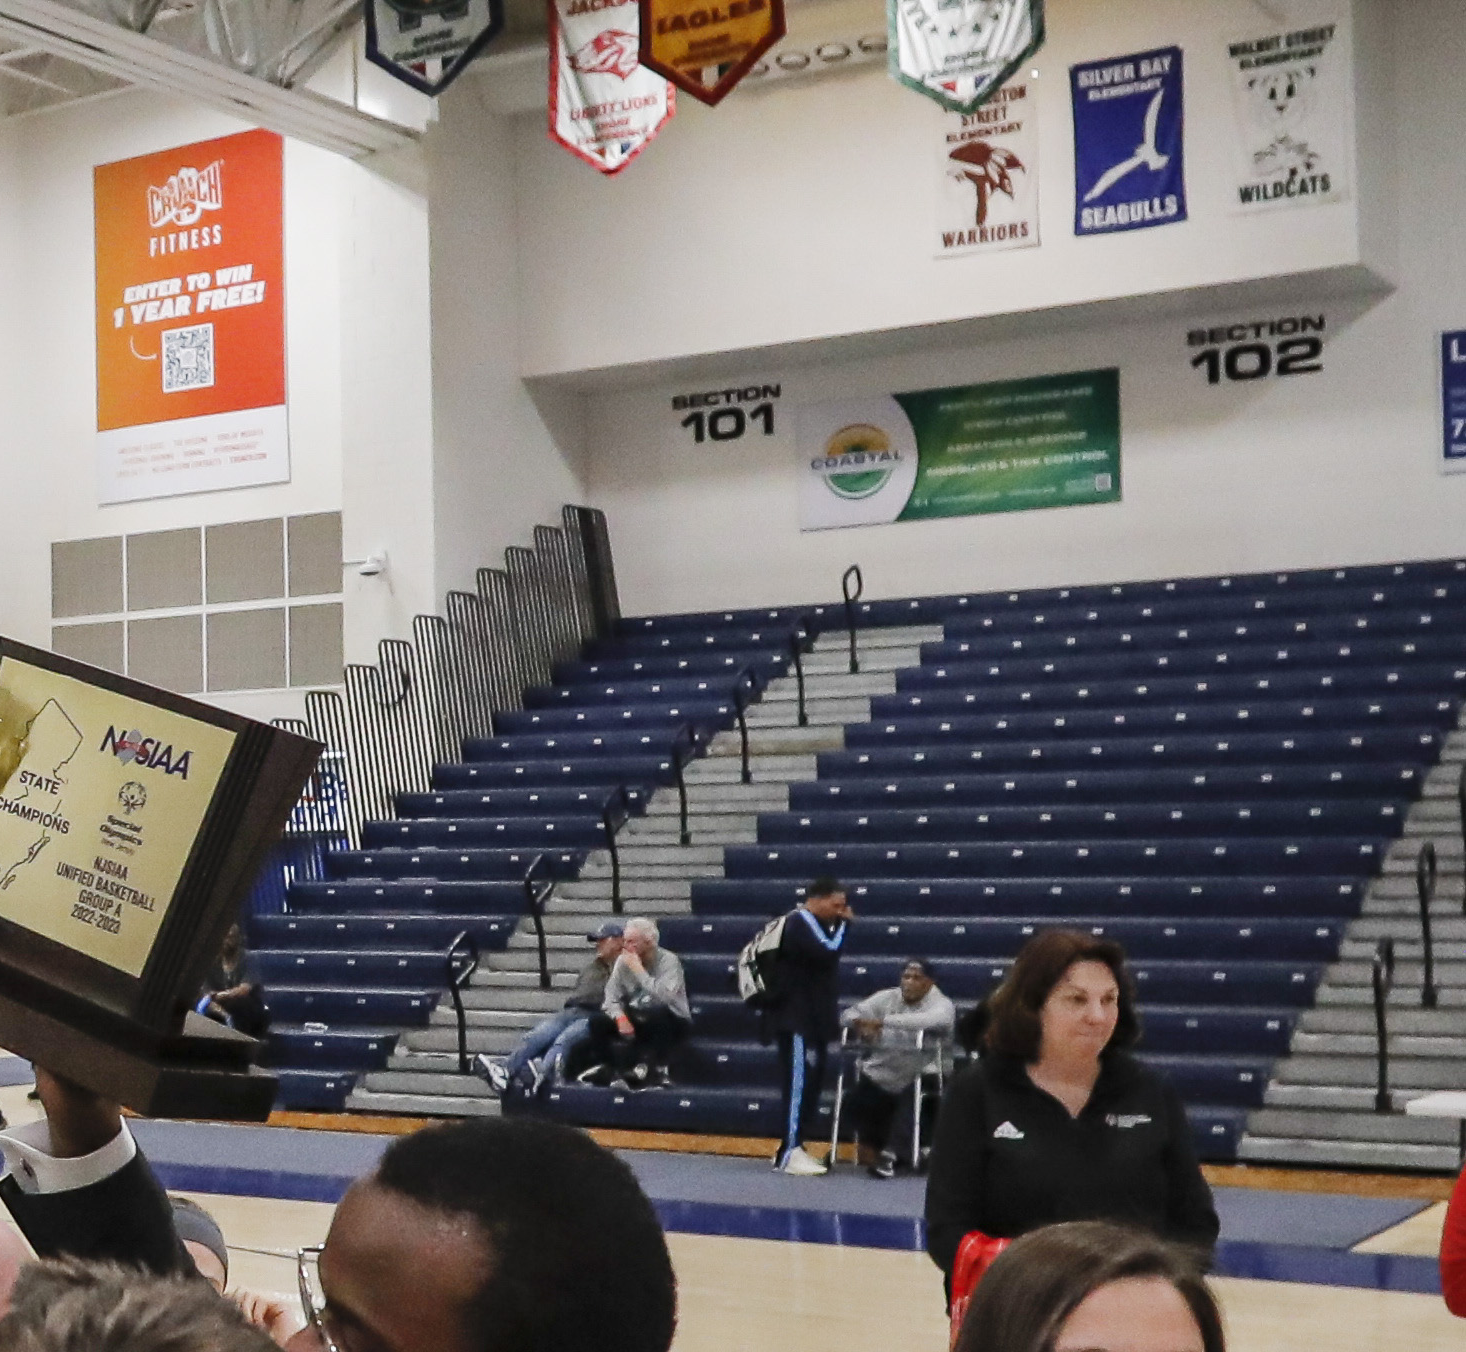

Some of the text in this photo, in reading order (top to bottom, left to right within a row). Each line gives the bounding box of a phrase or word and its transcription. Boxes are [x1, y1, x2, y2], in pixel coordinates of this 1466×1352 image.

[1078, 55, 1171, 88] SILVER BAY
[1239, 173, 1331, 204] WILDCATS
[1081, 194, 1178, 228] SEAGULLS
[149, 224, 223, 258] FITNESS
[942, 221, 1029, 248] WARRIORS
[123, 263, 254, 305] ENTER TO WIN
[113, 280, 266, 329] 1 YEAR FREE!
[1187, 313, 1325, 346] SECTION
[1191, 336, 1324, 384] 102
[671, 383, 782, 411] SECTION
[681, 401, 774, 443] 101
[100, 725, 194, 780] NSIAA
[19, 770, 61, 796] STATE
[94, 856, 128, 881] NJSIAA
[56, 861, 155, 912] UNIFIED BASKETBALL
[78, 889, 123, 917] GROUP A
[71, 903, 121, 935] 2022-2023
